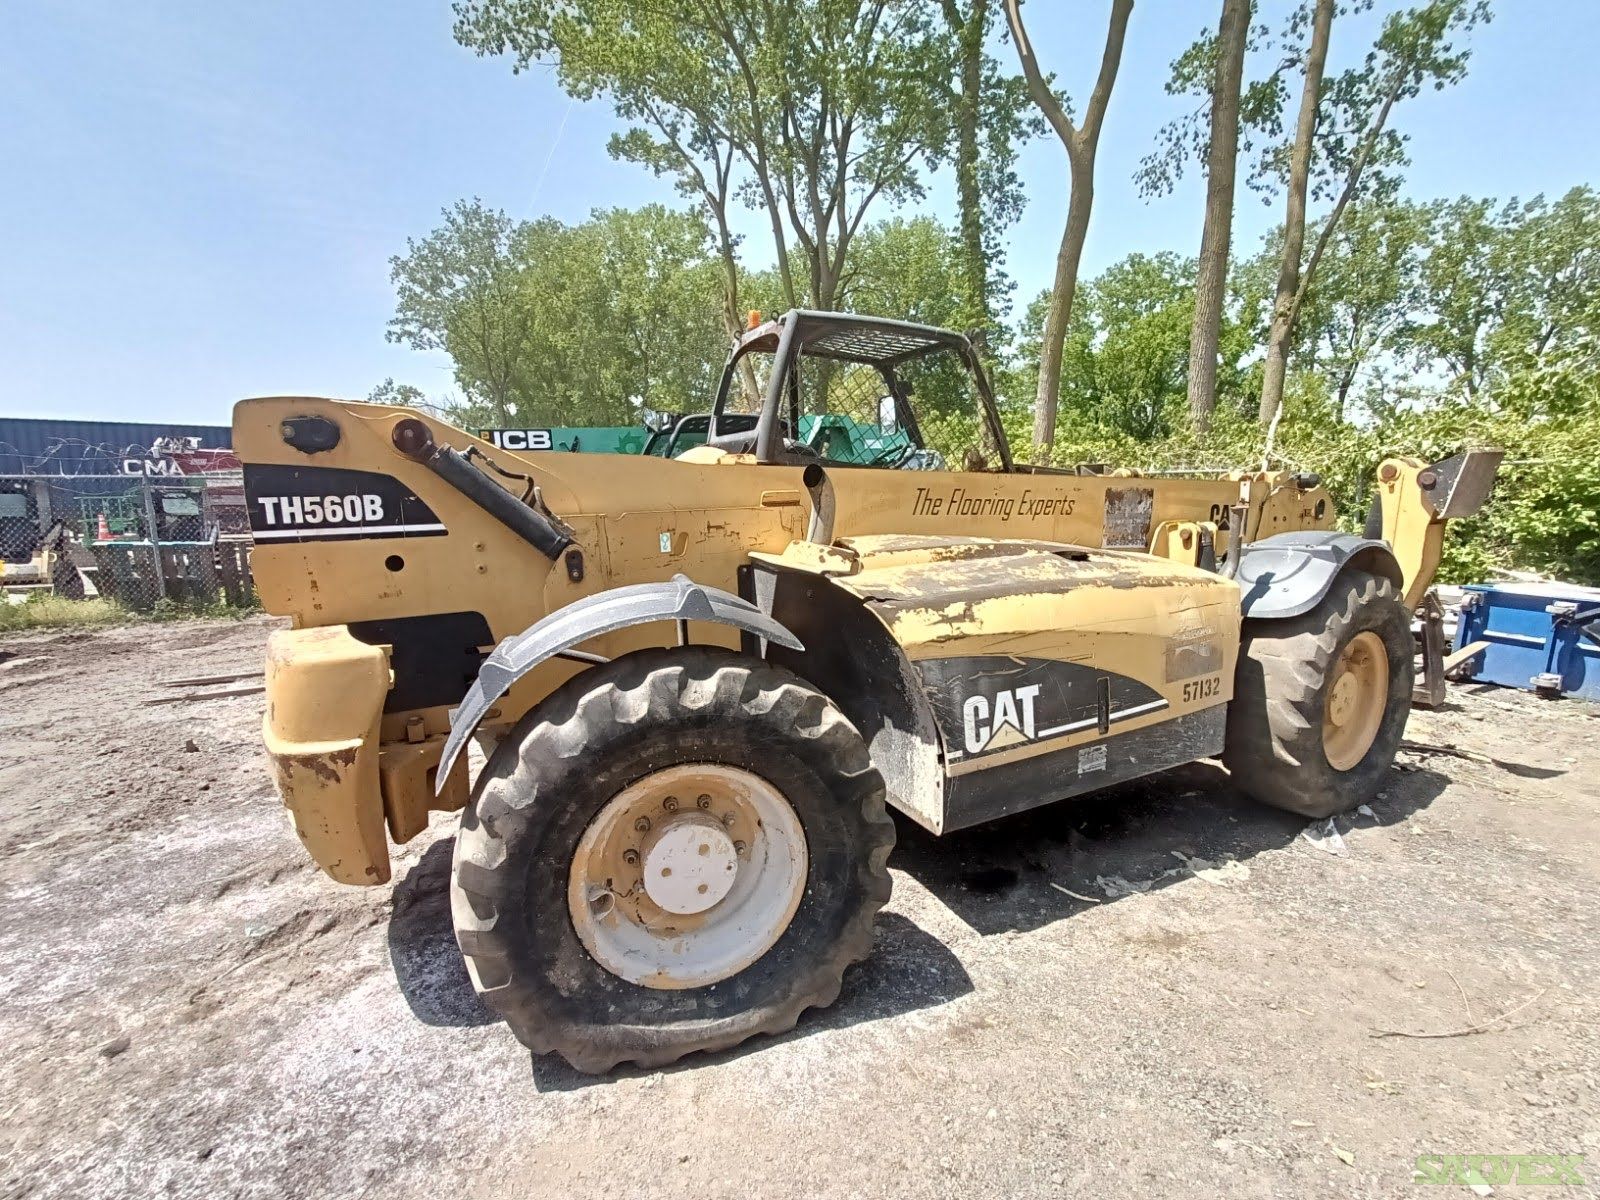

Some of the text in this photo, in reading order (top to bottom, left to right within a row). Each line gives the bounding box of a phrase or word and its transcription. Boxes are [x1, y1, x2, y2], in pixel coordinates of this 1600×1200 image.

[123, 459, 186, 476] CMA
[257, 494, 384, 525] TH560B
[912, 487, 943, 516] The
[946, 488, 1015, 521] Flooring
[1017, 489, 1075, 521] Experts
[1209, 503, 1231, 531] CA
[1183, 677, 1220, 702] 57132
[963, 684, 1040, 753] CAT
